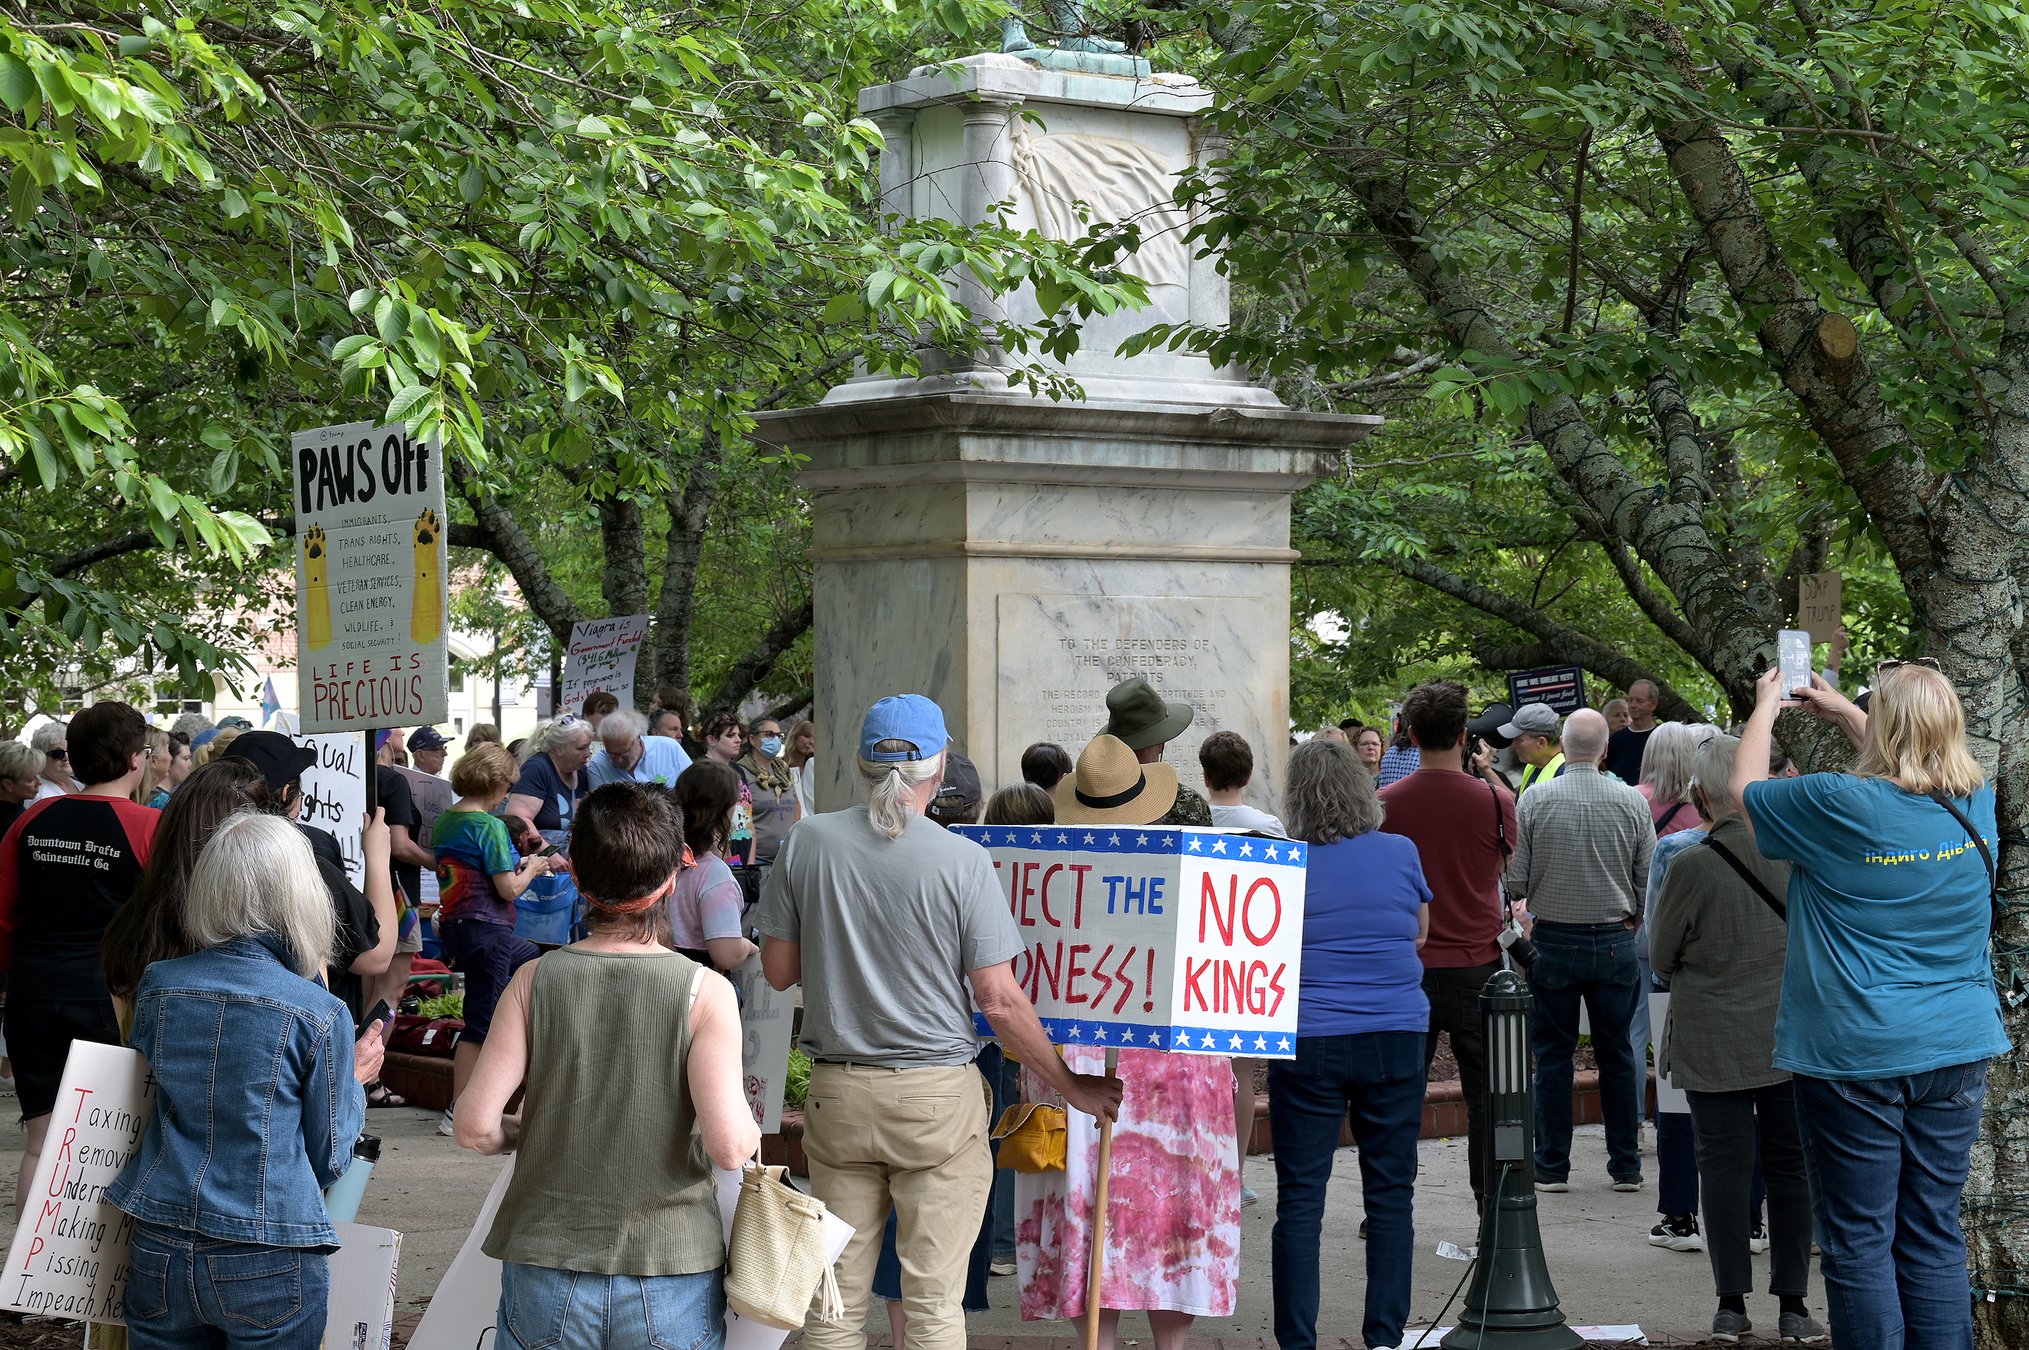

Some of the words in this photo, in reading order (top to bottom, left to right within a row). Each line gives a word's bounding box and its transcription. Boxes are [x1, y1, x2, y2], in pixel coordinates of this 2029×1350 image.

[299, 438, 376, 514] PAWS
[381, 432, 430, 495] OFF
[338, 536, 366, 551] TRANS
[336, 578, 368, 594] VETERAN
[340, 600, 364, 615] CLEAN
[1806, 604, 1835, 624] TRUMP
[577, 623, 615, 638] Viagra
[619, 619, 631, 630] is
[342, 640, 366, 651] SOCIAL
[571, 637, 615, 656] Government
[616, 630, 643, 646] Funded
[1059, 638, 1076, 650] TO
[1083, 638, 1108, 650] THE
[1115, 639, 1188, 650] DEFENDERS
[1194, 639, 1210, 650] OF
[313, 660, 372, 682] LIFE
[389, 653, 421, 671] IS
[1075, 655, 1100, 667] THE
[1107, 655, 1198, 669] CONFEDERACY,
[566, 679, 580, 690] If
[583, 674, 613, 689] pregnancy
[615, 671, 622, 679] is
[621, 683, 629, 691] so
[314, 674, 423, 723] PRECIOUS
[1041, 690, 1060, 700] THE
[1064, 690, 1100, 700] RECORD
[1210, 690, 1226, 698] AND
[1051, 704, 1091, 714] HEROISM
[1095, 704, 1105, 714] IN
[1046, 719, 1087, 728] COUNTRY
[1092, 719, 1101, 728] IS
[1209, 717, 1222, 727] OF
[1056, 732, 1088, 742] LOYAL
[299, 781, 344, 823] ights
[27, 835, 81, 851] Downtown
[85, 840, 121, 858] Drafts
[32, 850, 91, 867] Gainesville
[93, 857, 109, 871] Ga
[1865, 847, 1930, 866] індиго
[992, 861, 1092, 930] JECT
[1102, 875, 1166, 915] THE
[1198, 871, 1282, 947] NO
[1012, 937, 1155, 1015] DNESS!
[1183, 956, 1286, 1017] KINGS
[74, 1087, 142, 1145] Taxing
[34, 1199, 106, 1253] Making
[24, 1237, 100, 1287] Pissing
[11, 1273, 98, 1318] Impeach,
